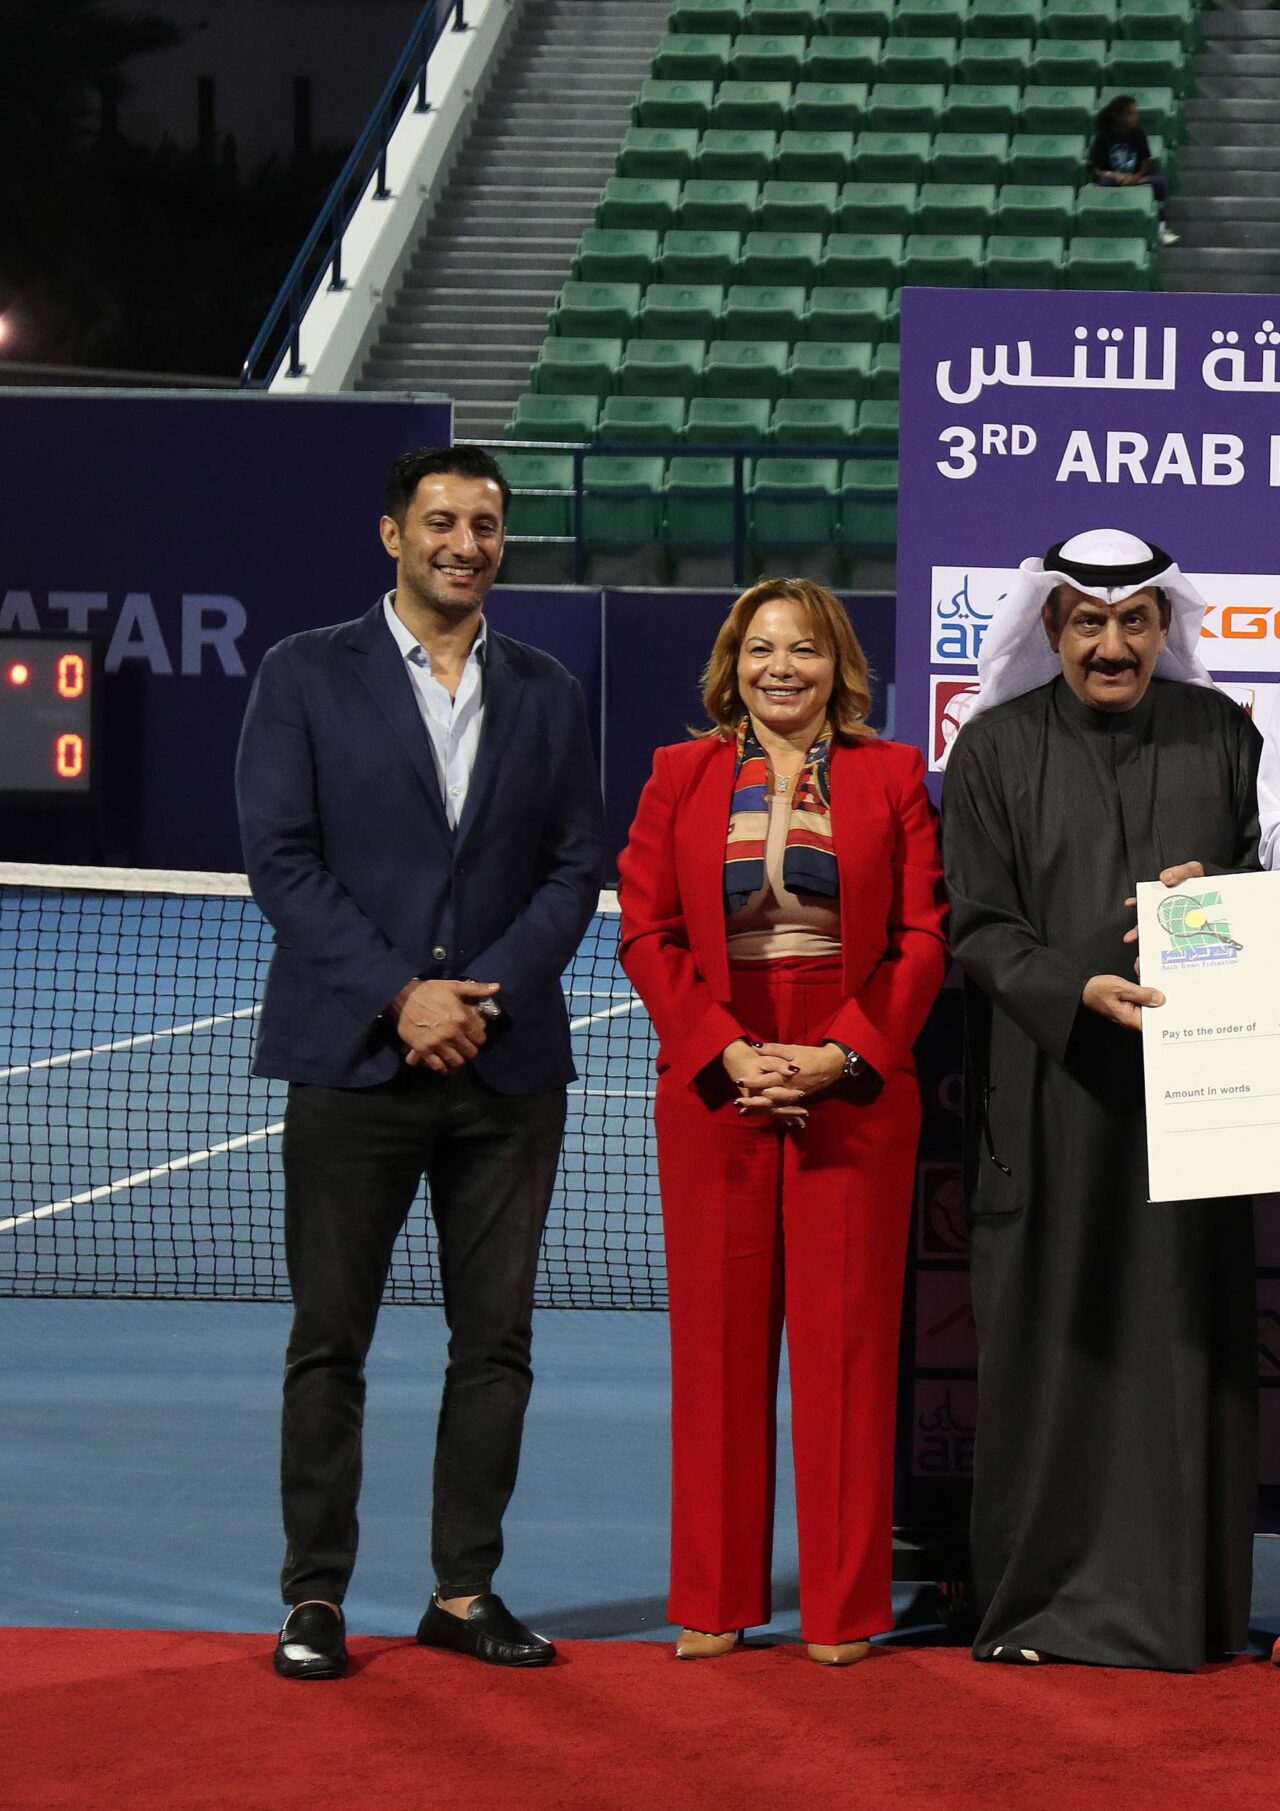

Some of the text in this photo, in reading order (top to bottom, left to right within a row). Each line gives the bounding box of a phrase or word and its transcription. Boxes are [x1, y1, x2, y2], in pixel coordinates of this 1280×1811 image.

[936, 326, 1176, 404] للتنس
[936, 423, 1037, 480] 3RD
[1055, 430, 1245, 486] ARAB
[58, 654, 84, 698] 0
[57, 734, 83, 777] 0
[1162, 1022, 1257, 1039] Pay to the order of
[1164, 1084, 1251, 1099] Amount in words
